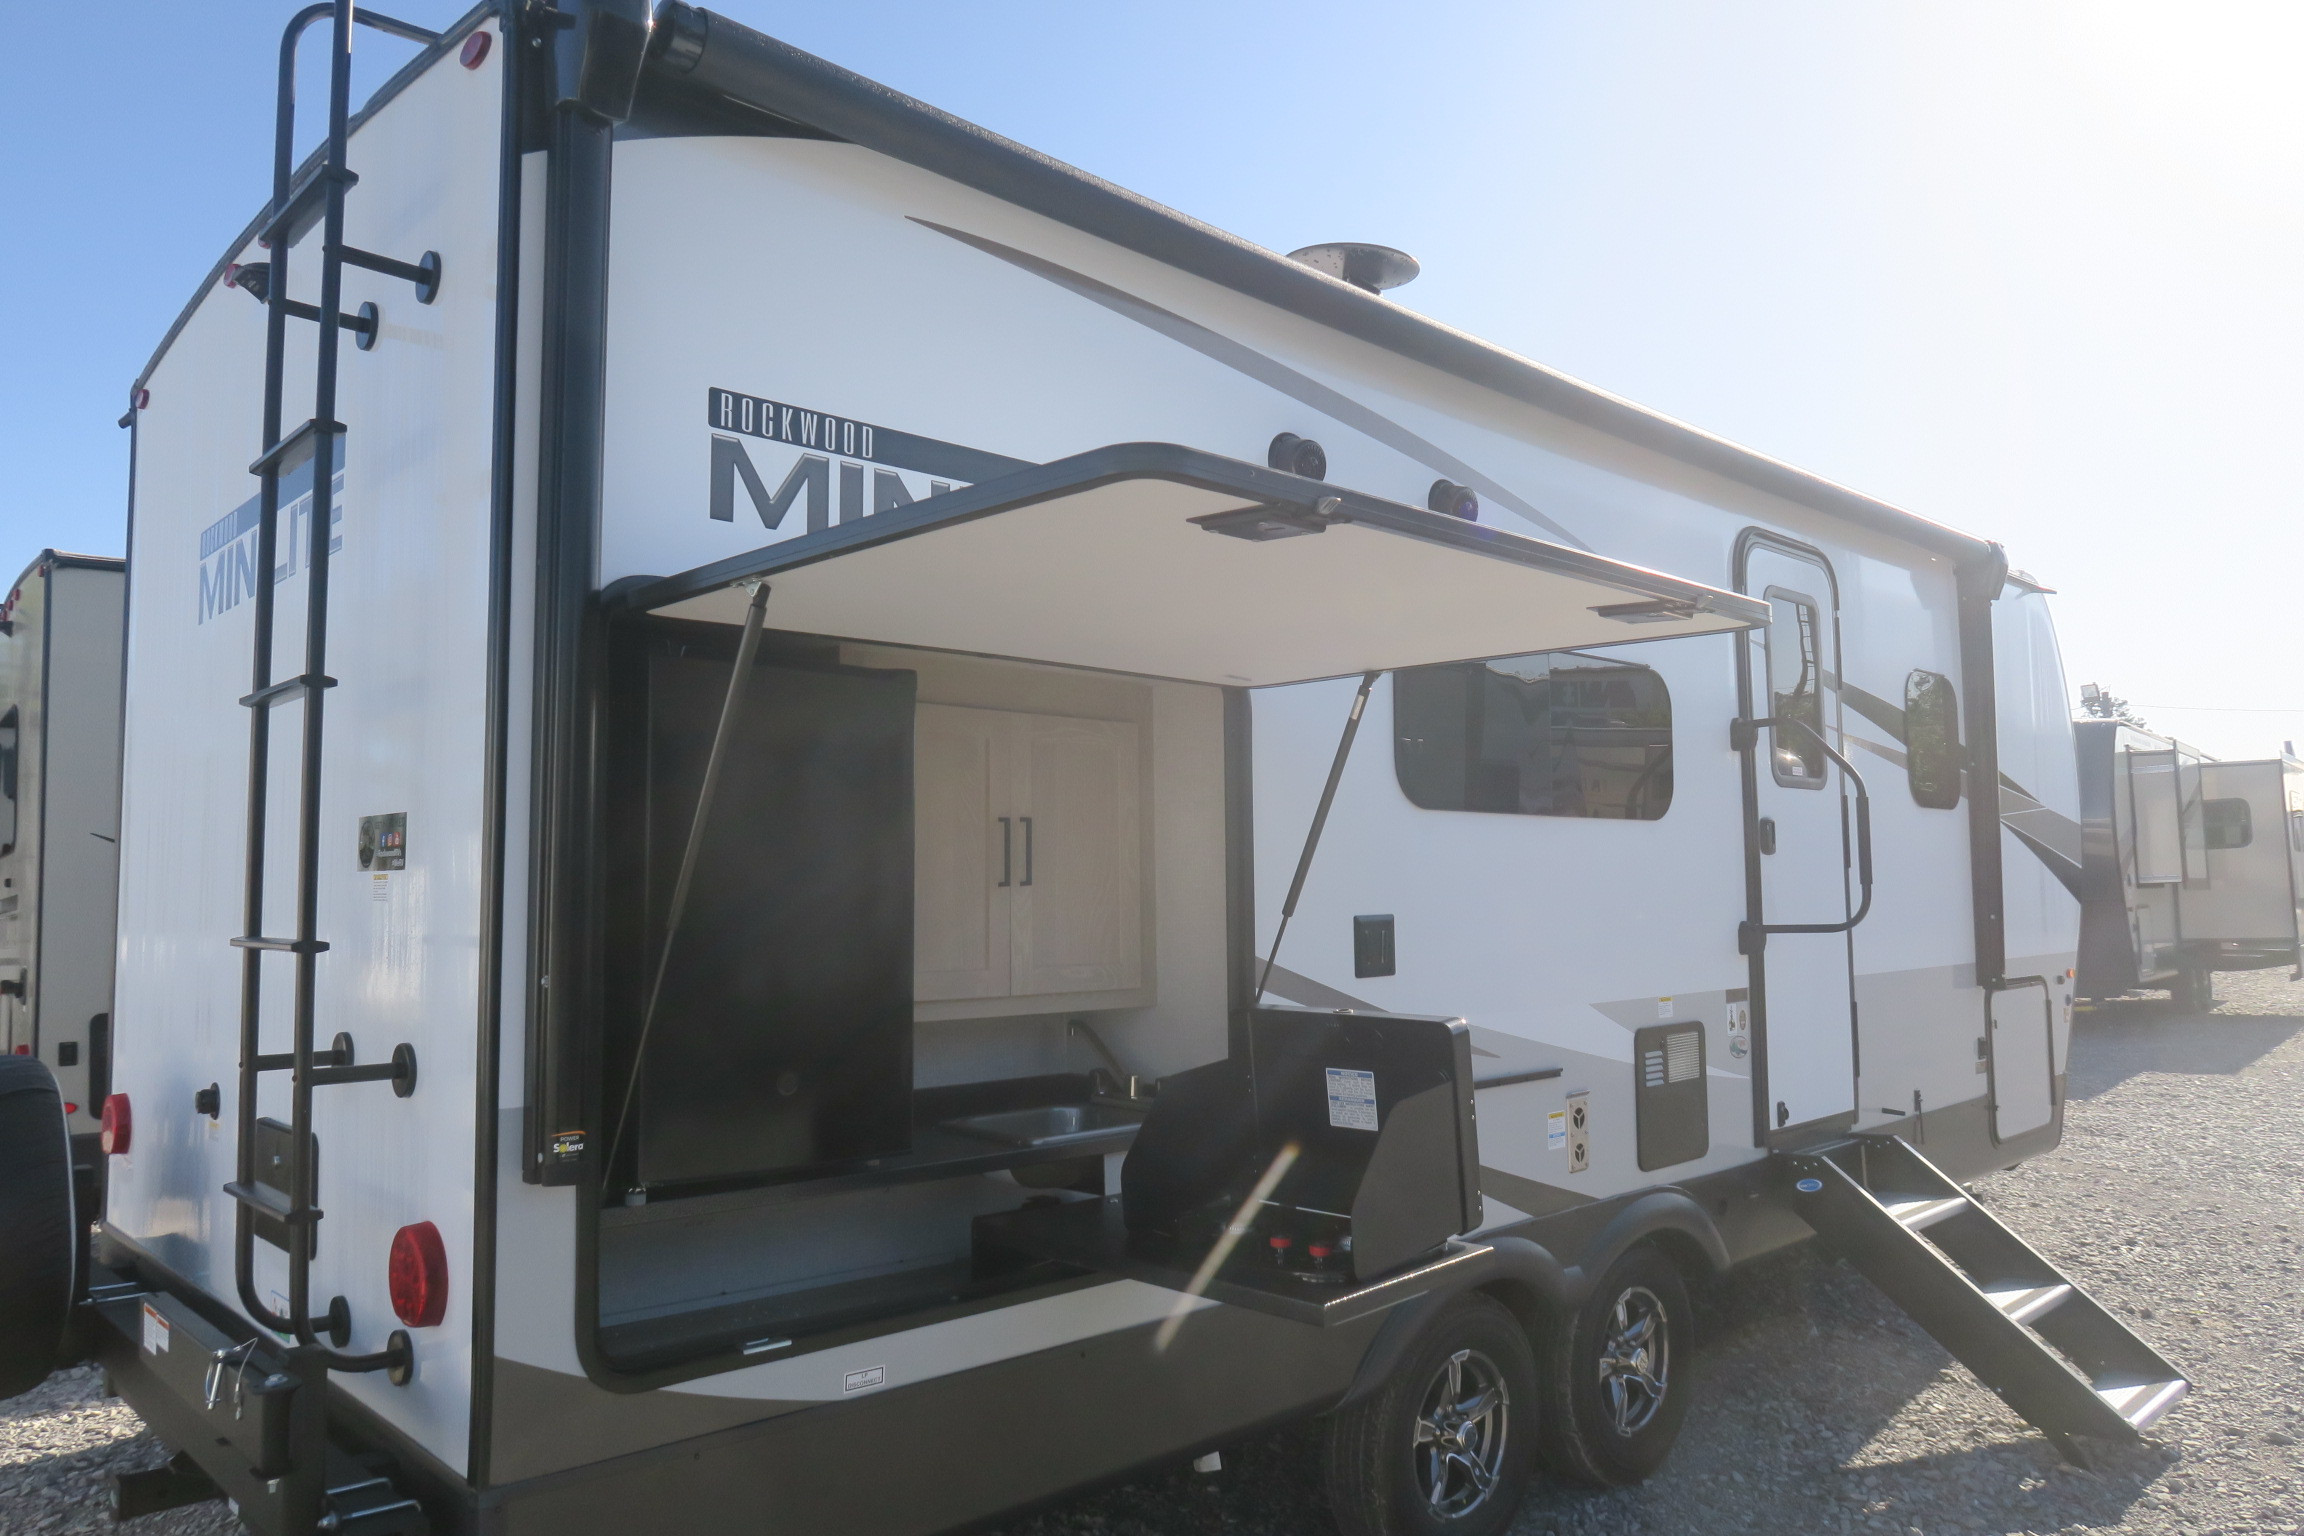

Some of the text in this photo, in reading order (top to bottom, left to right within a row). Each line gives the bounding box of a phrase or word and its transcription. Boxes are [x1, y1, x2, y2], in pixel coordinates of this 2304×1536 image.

[719, 391, 874, 460] ROCKWOOD
[553, 1142, 584, 1152] Solera
[848, 1377, 880, 1388] DISCONNECT
